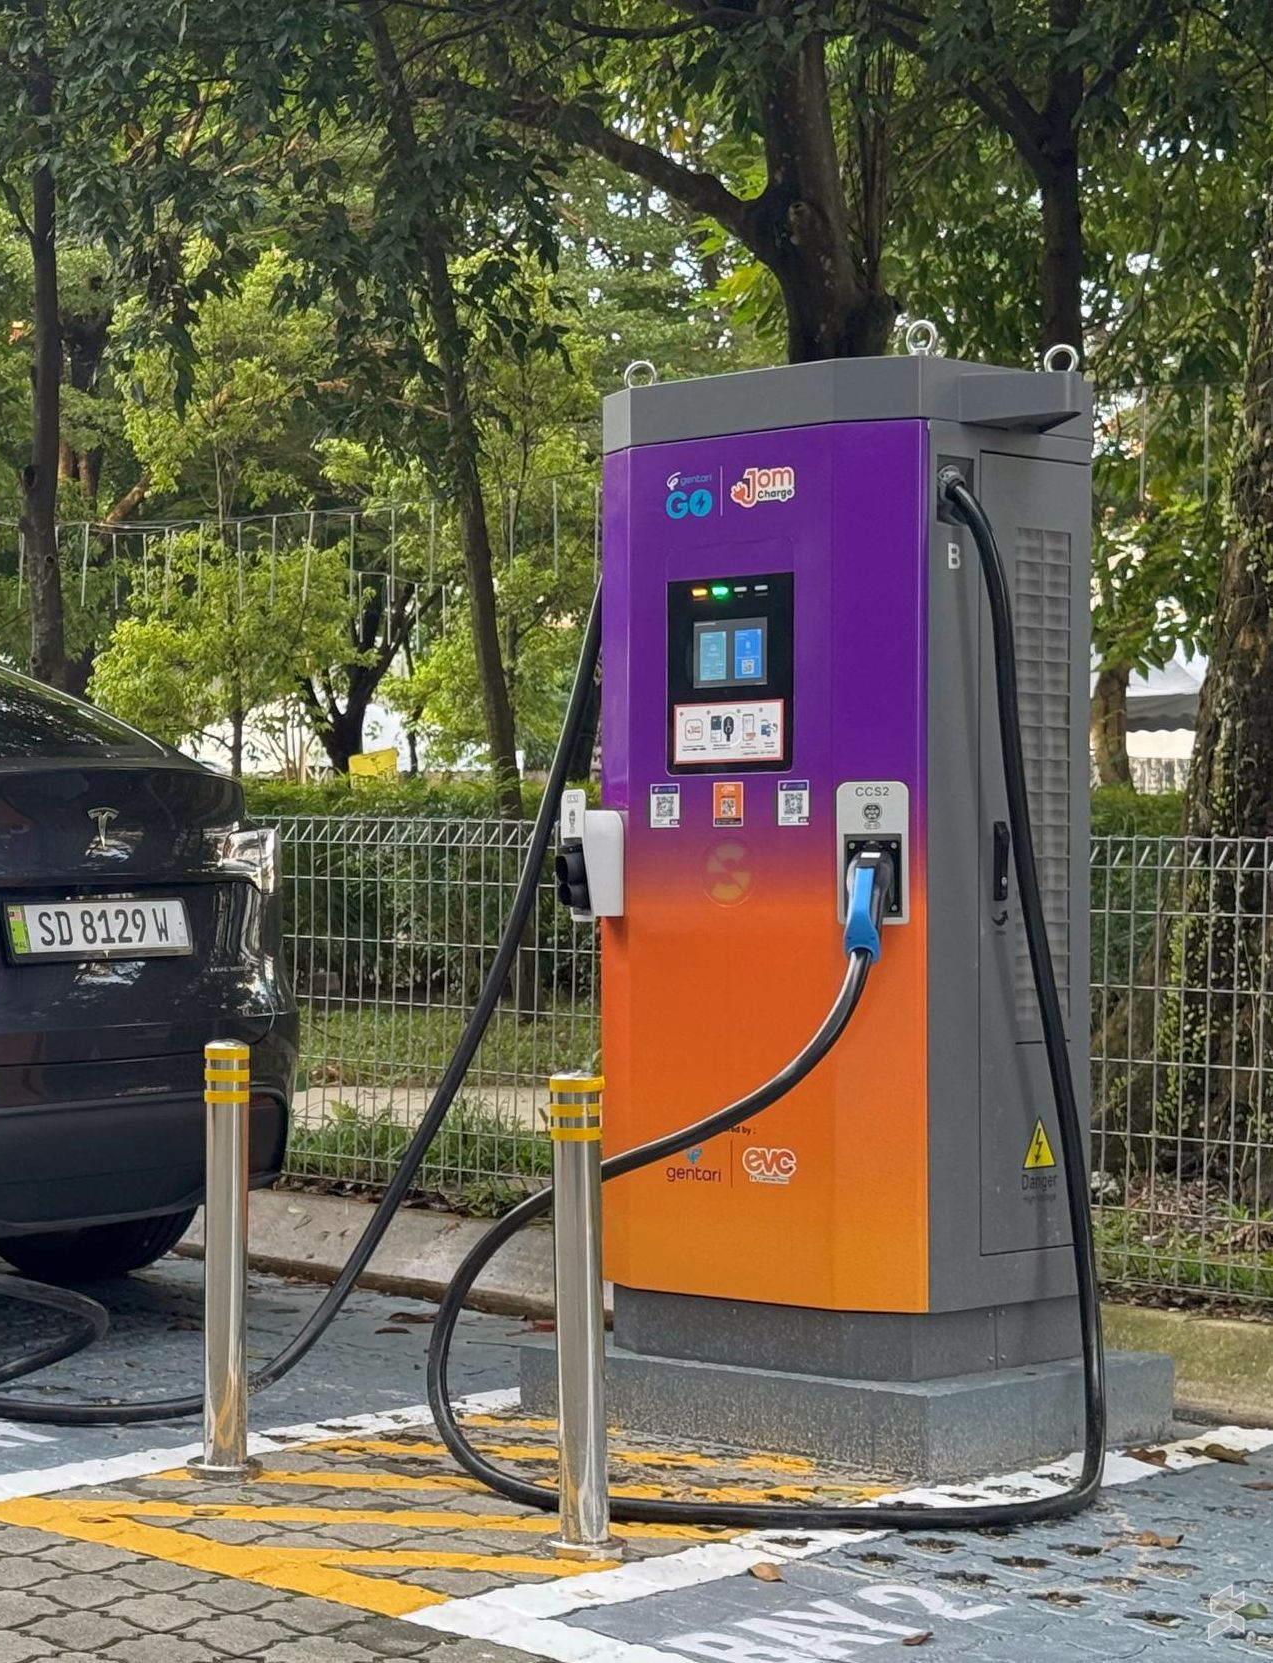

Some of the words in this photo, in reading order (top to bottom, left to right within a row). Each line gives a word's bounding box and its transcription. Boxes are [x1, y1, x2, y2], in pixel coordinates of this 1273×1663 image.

[666, 488, 713, 519] GO
[947, 542, 961, 570] B
[855, 786, 890, 797] CCS2
[38, 911, 73, 946] SD
[80, 908, 146, 944] 8129
[152, 907, 169, 942] W
[666, 1167, 721, 1182] gentari
[1021, 1174, 1058, 1192] Danger
[856, 1585, 1012, 1621] 2
